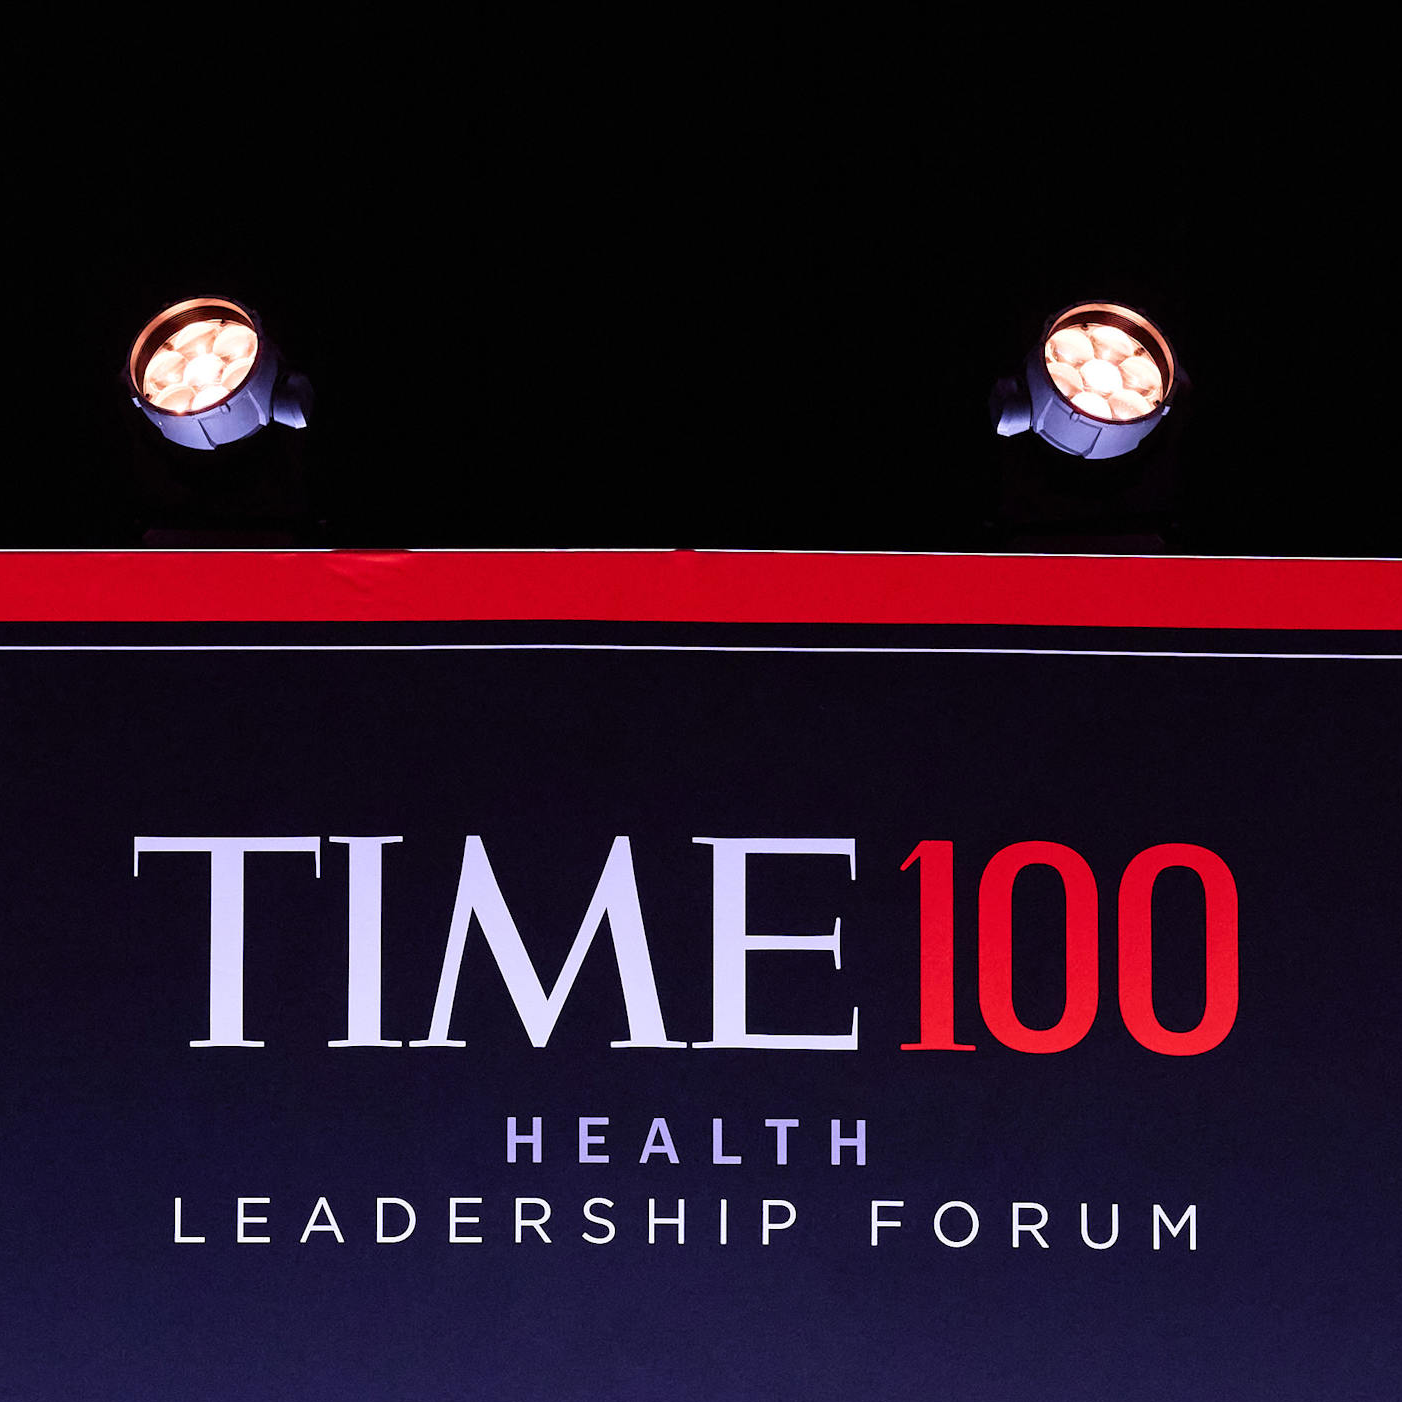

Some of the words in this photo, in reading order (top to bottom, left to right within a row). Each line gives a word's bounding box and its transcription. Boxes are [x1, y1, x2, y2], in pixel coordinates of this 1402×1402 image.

[505, 1116, 867, 1166] HEALTH
[174, 1196, 798, 1247] LEADERSHIP
[870, 1200, 1198, 1252] FORUM
